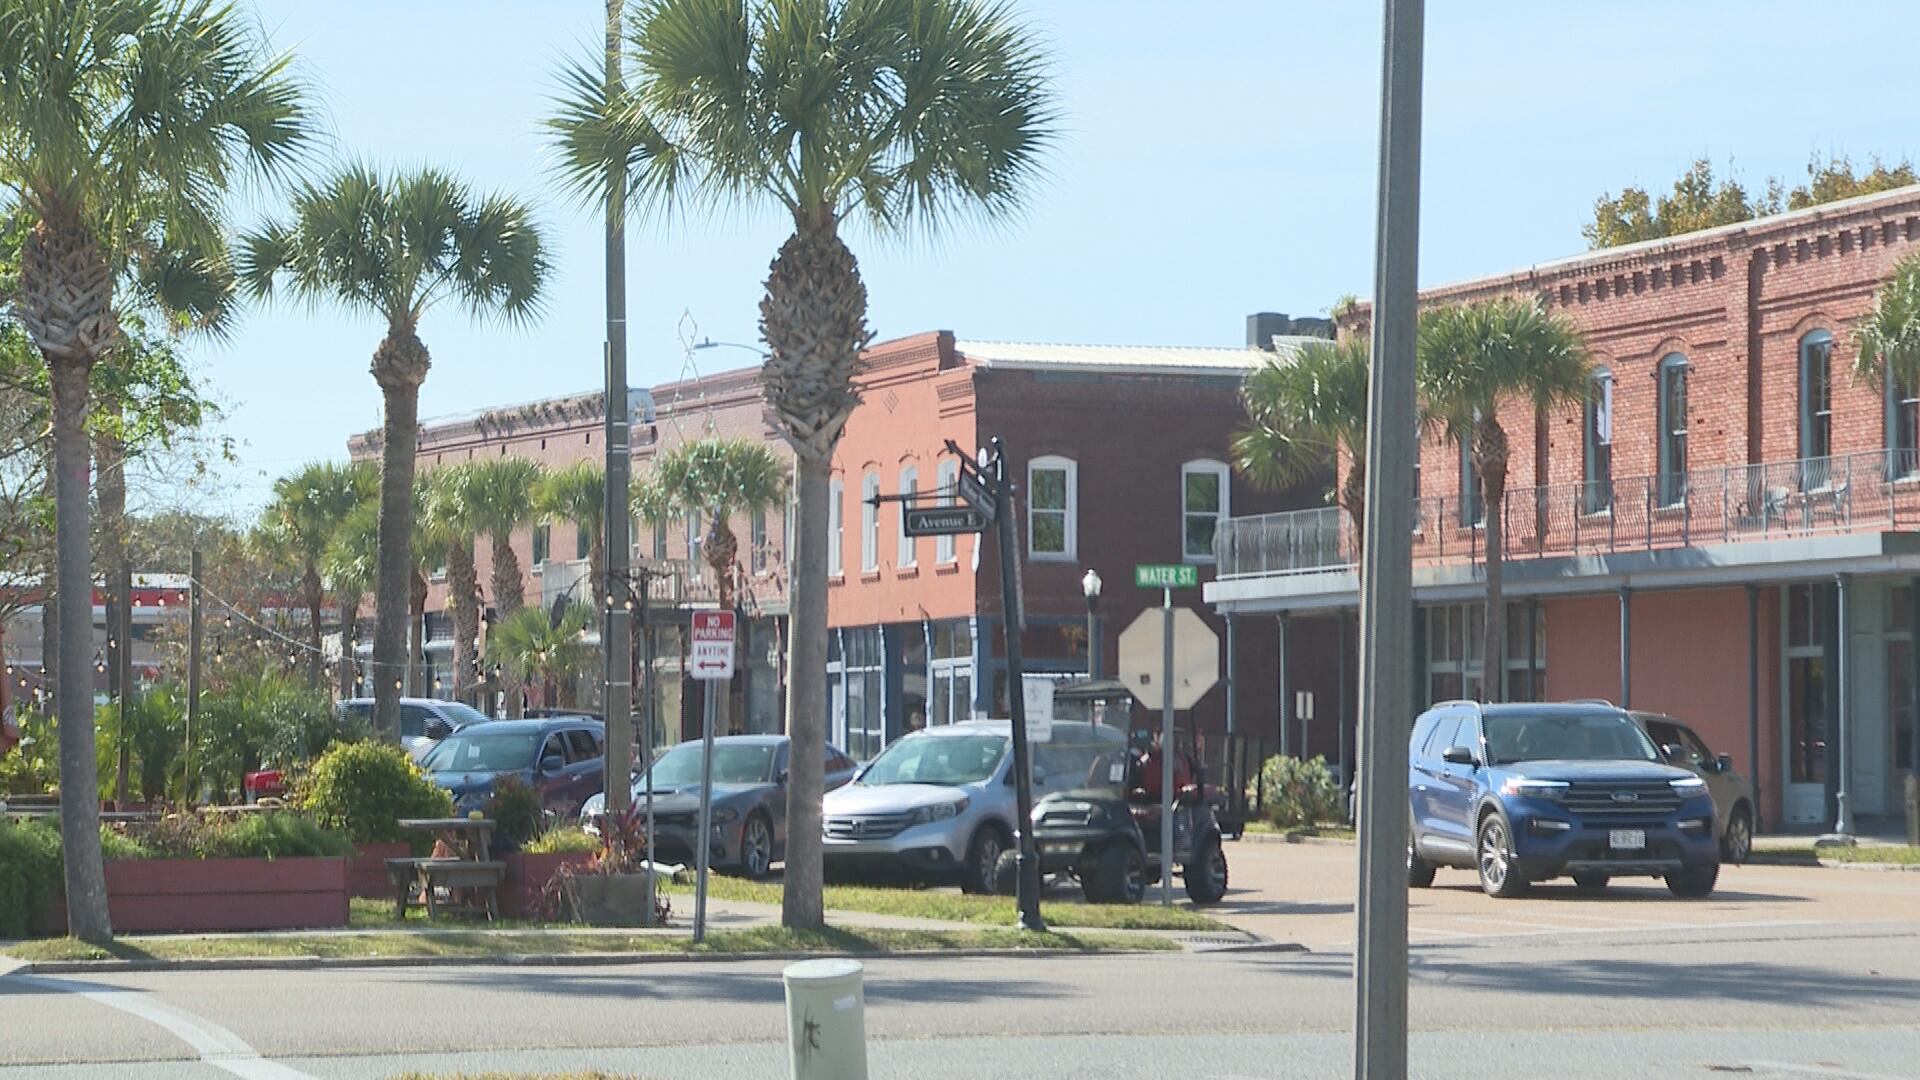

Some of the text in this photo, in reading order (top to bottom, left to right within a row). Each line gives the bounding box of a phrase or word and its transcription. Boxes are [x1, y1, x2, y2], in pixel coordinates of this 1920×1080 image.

[918, 516, 965, 528] Avenue
[1140, 567, 1176, 585] WATER
[707, 615, 720, 627] NO
[694, 627, 733, 640] PARKING
[697, 646, 729, 657] ANYTIME
